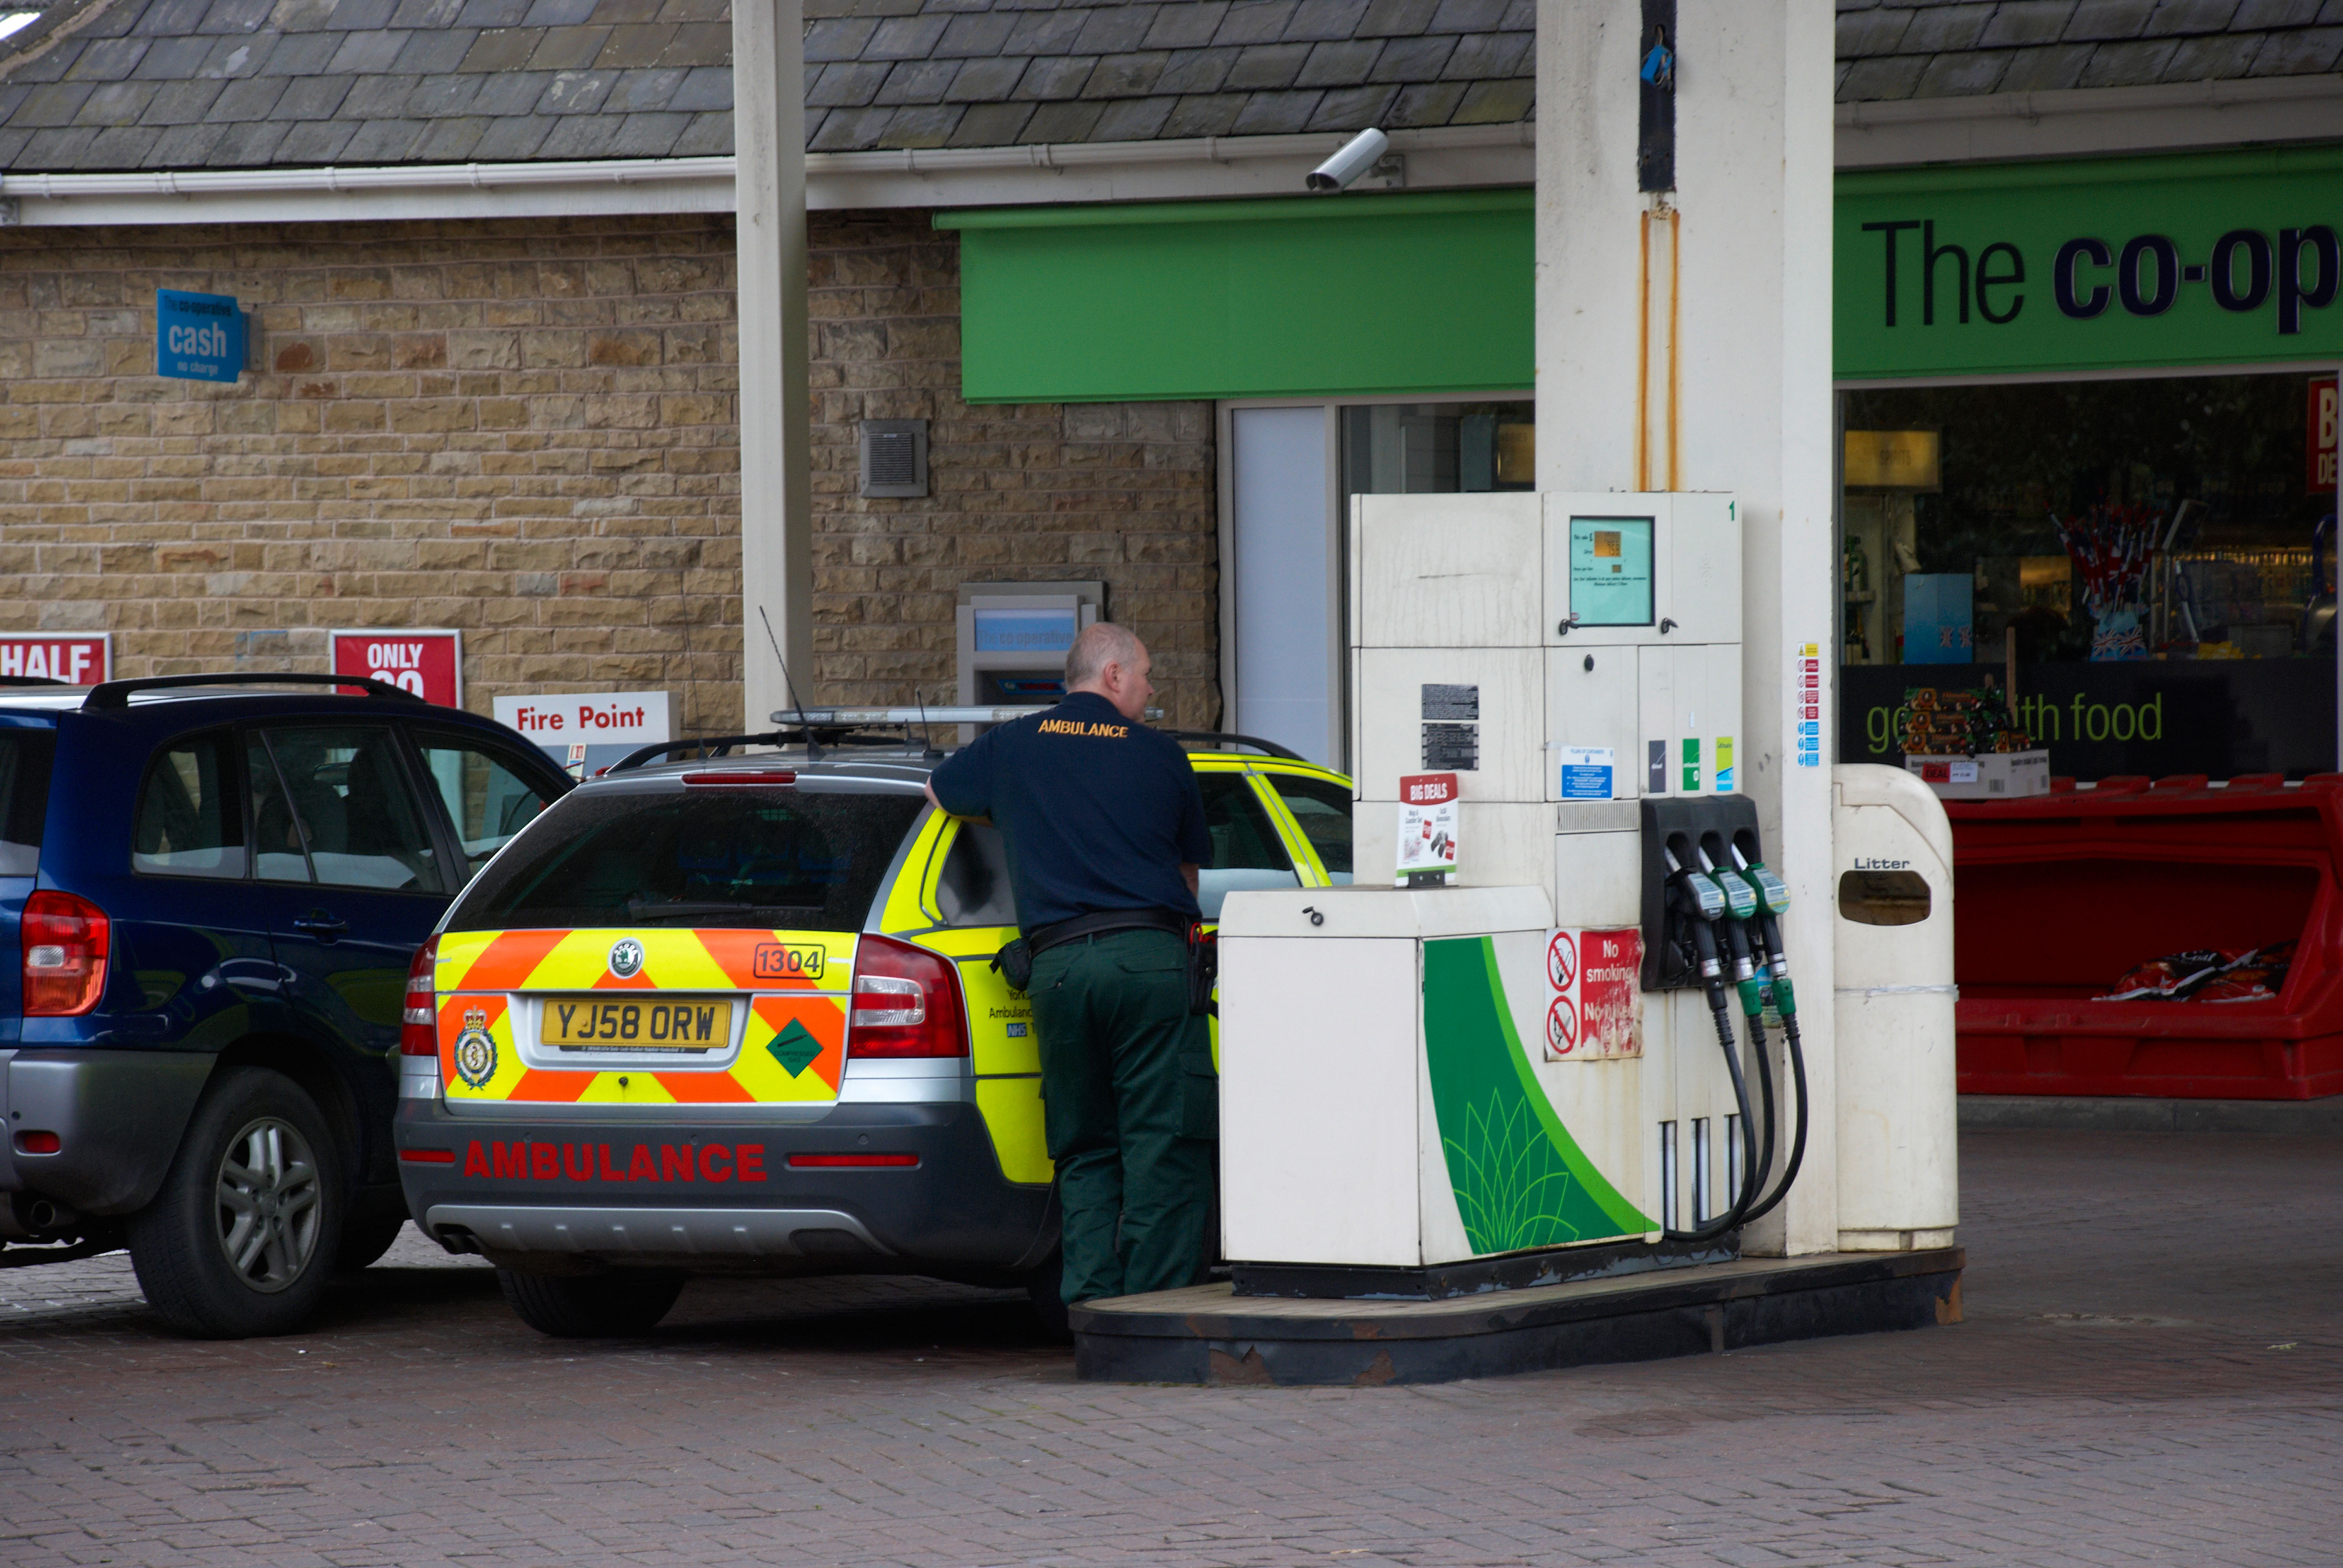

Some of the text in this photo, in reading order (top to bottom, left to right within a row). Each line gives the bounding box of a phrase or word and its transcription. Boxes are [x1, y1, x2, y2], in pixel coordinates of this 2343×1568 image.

[1862, 219, 2341, 334] The co-op
[169, 322, 227, 358] cash
[1729, 500, 1734, 521] 1
[0, 645, 91, 684] HALF
[367, 643, 424, 669] ONLY
[517, 703, 645, 731] Fire Point
[2071, 692, 2163, 741] food
[1037, 719, 1129, 738] AMBULANCE
[1410, 782, 1448, 801] BIG DEALS
[1855, 857, 1910, 869] Litter
[1603, 939, 1619, 958] No
[759, 950, 819, 973] 1304
[1586, 963, 1634, 985] smoking
[558, 1004, 715, 1040] YJ58 ORW
[989, 1006, 1032, 1019] Ambulanc
[1584, 1002, 1601, 1021] No
[1007, 1024, 1026, 1037] NHS
[463, 1139, 768, 1183] AMBULANCE
